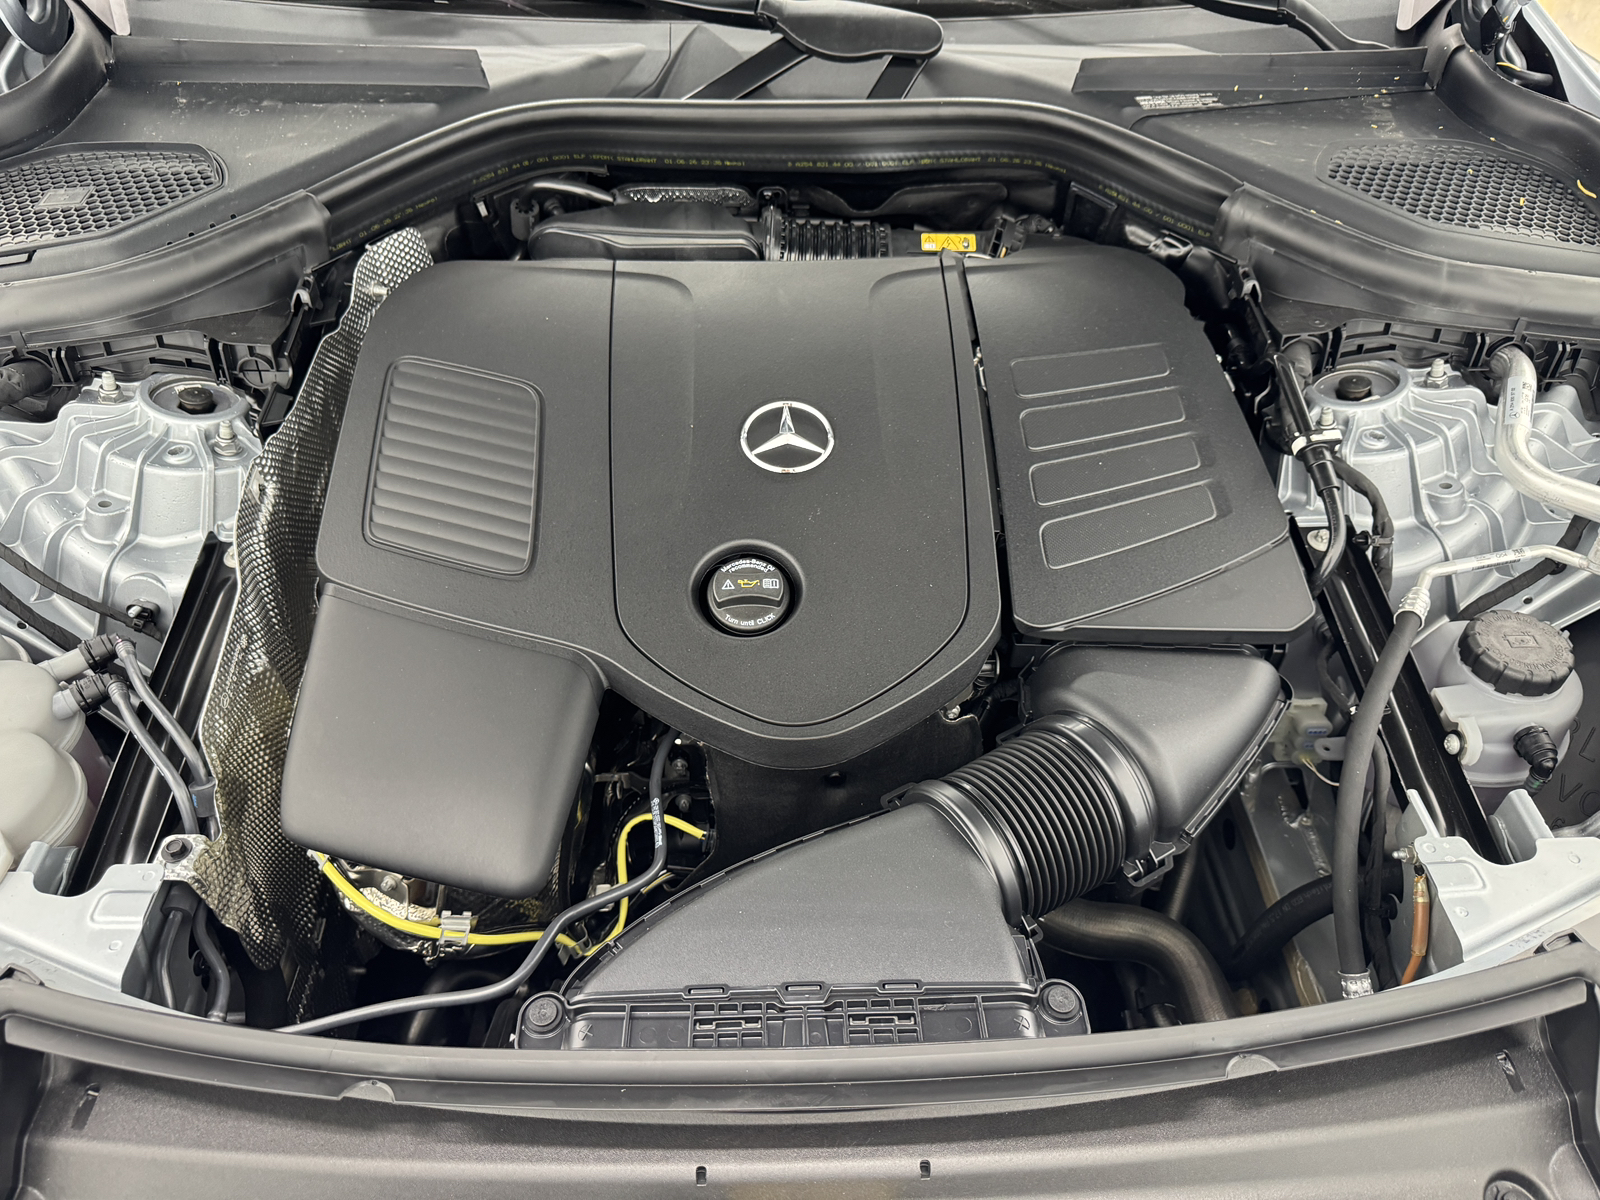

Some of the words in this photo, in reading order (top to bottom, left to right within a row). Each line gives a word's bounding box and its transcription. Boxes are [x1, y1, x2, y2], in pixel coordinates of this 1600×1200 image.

[720, 558, 766, 572] Mercedes-Benz
[728, 563, 768, 574] recommended
[725, 614, 738, 624] Turn
[757, 612, 776, 624] CLICK
